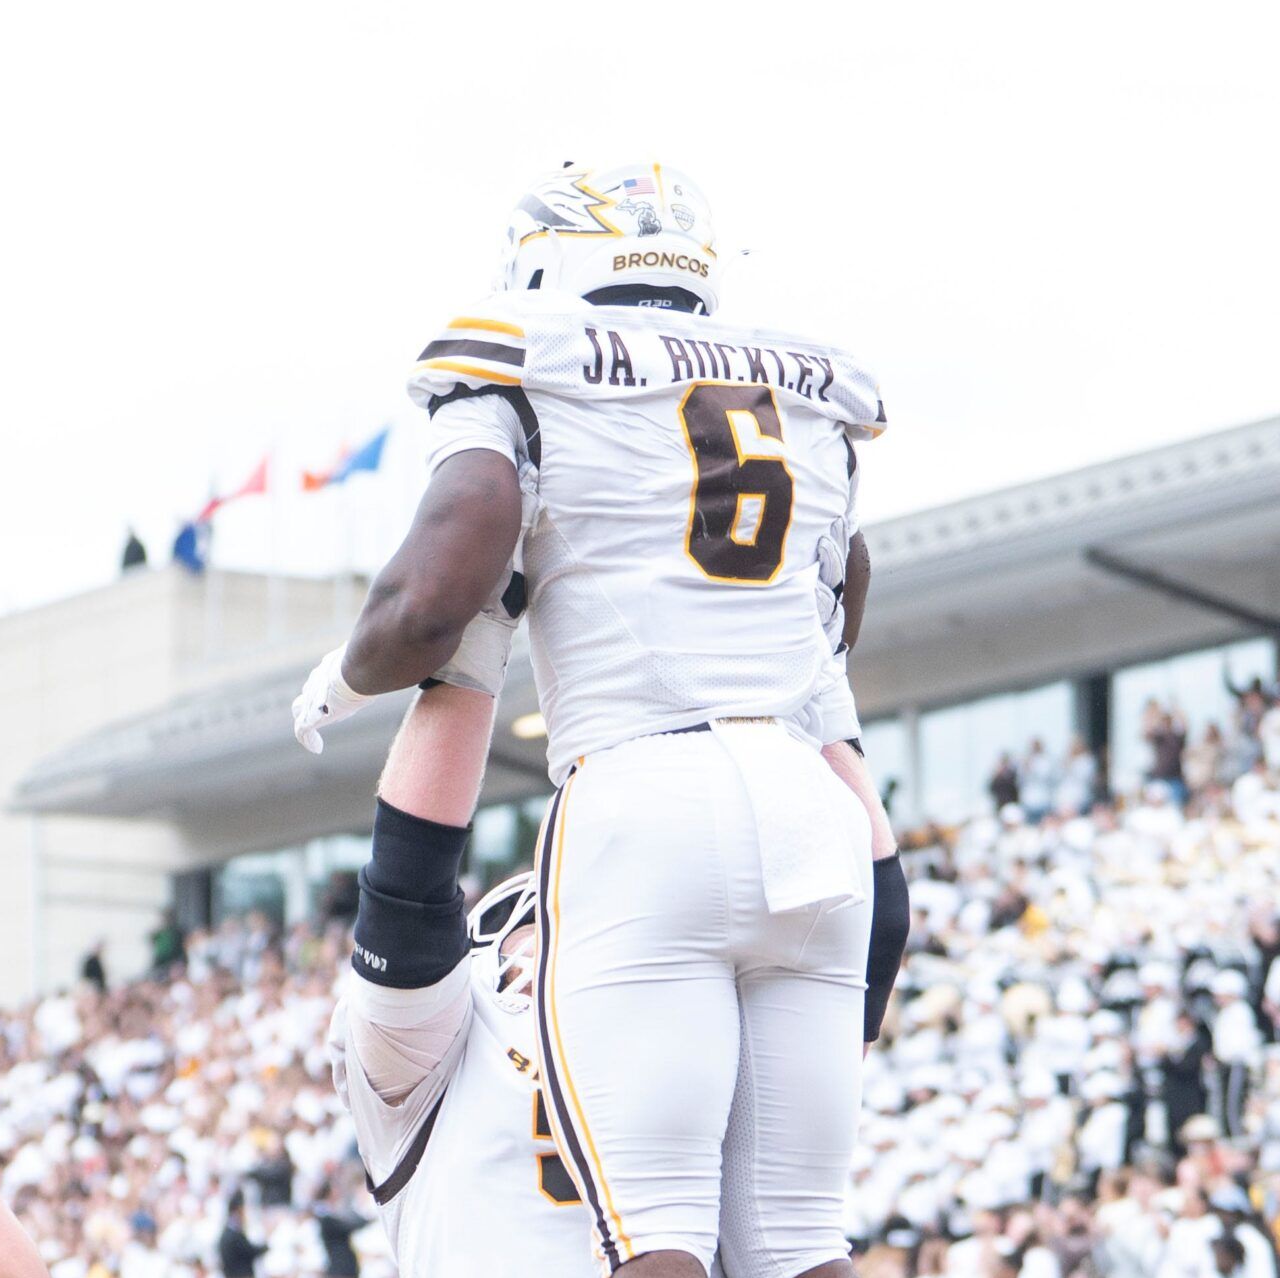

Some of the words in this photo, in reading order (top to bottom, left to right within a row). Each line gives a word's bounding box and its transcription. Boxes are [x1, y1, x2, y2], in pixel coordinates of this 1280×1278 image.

[612, 252, 710, 278] BRONCOS
[583, 328, 647, 387] JA.
[658, 335, 835, 402] BUCKLEY
[678, 380, 794, 585] 6
